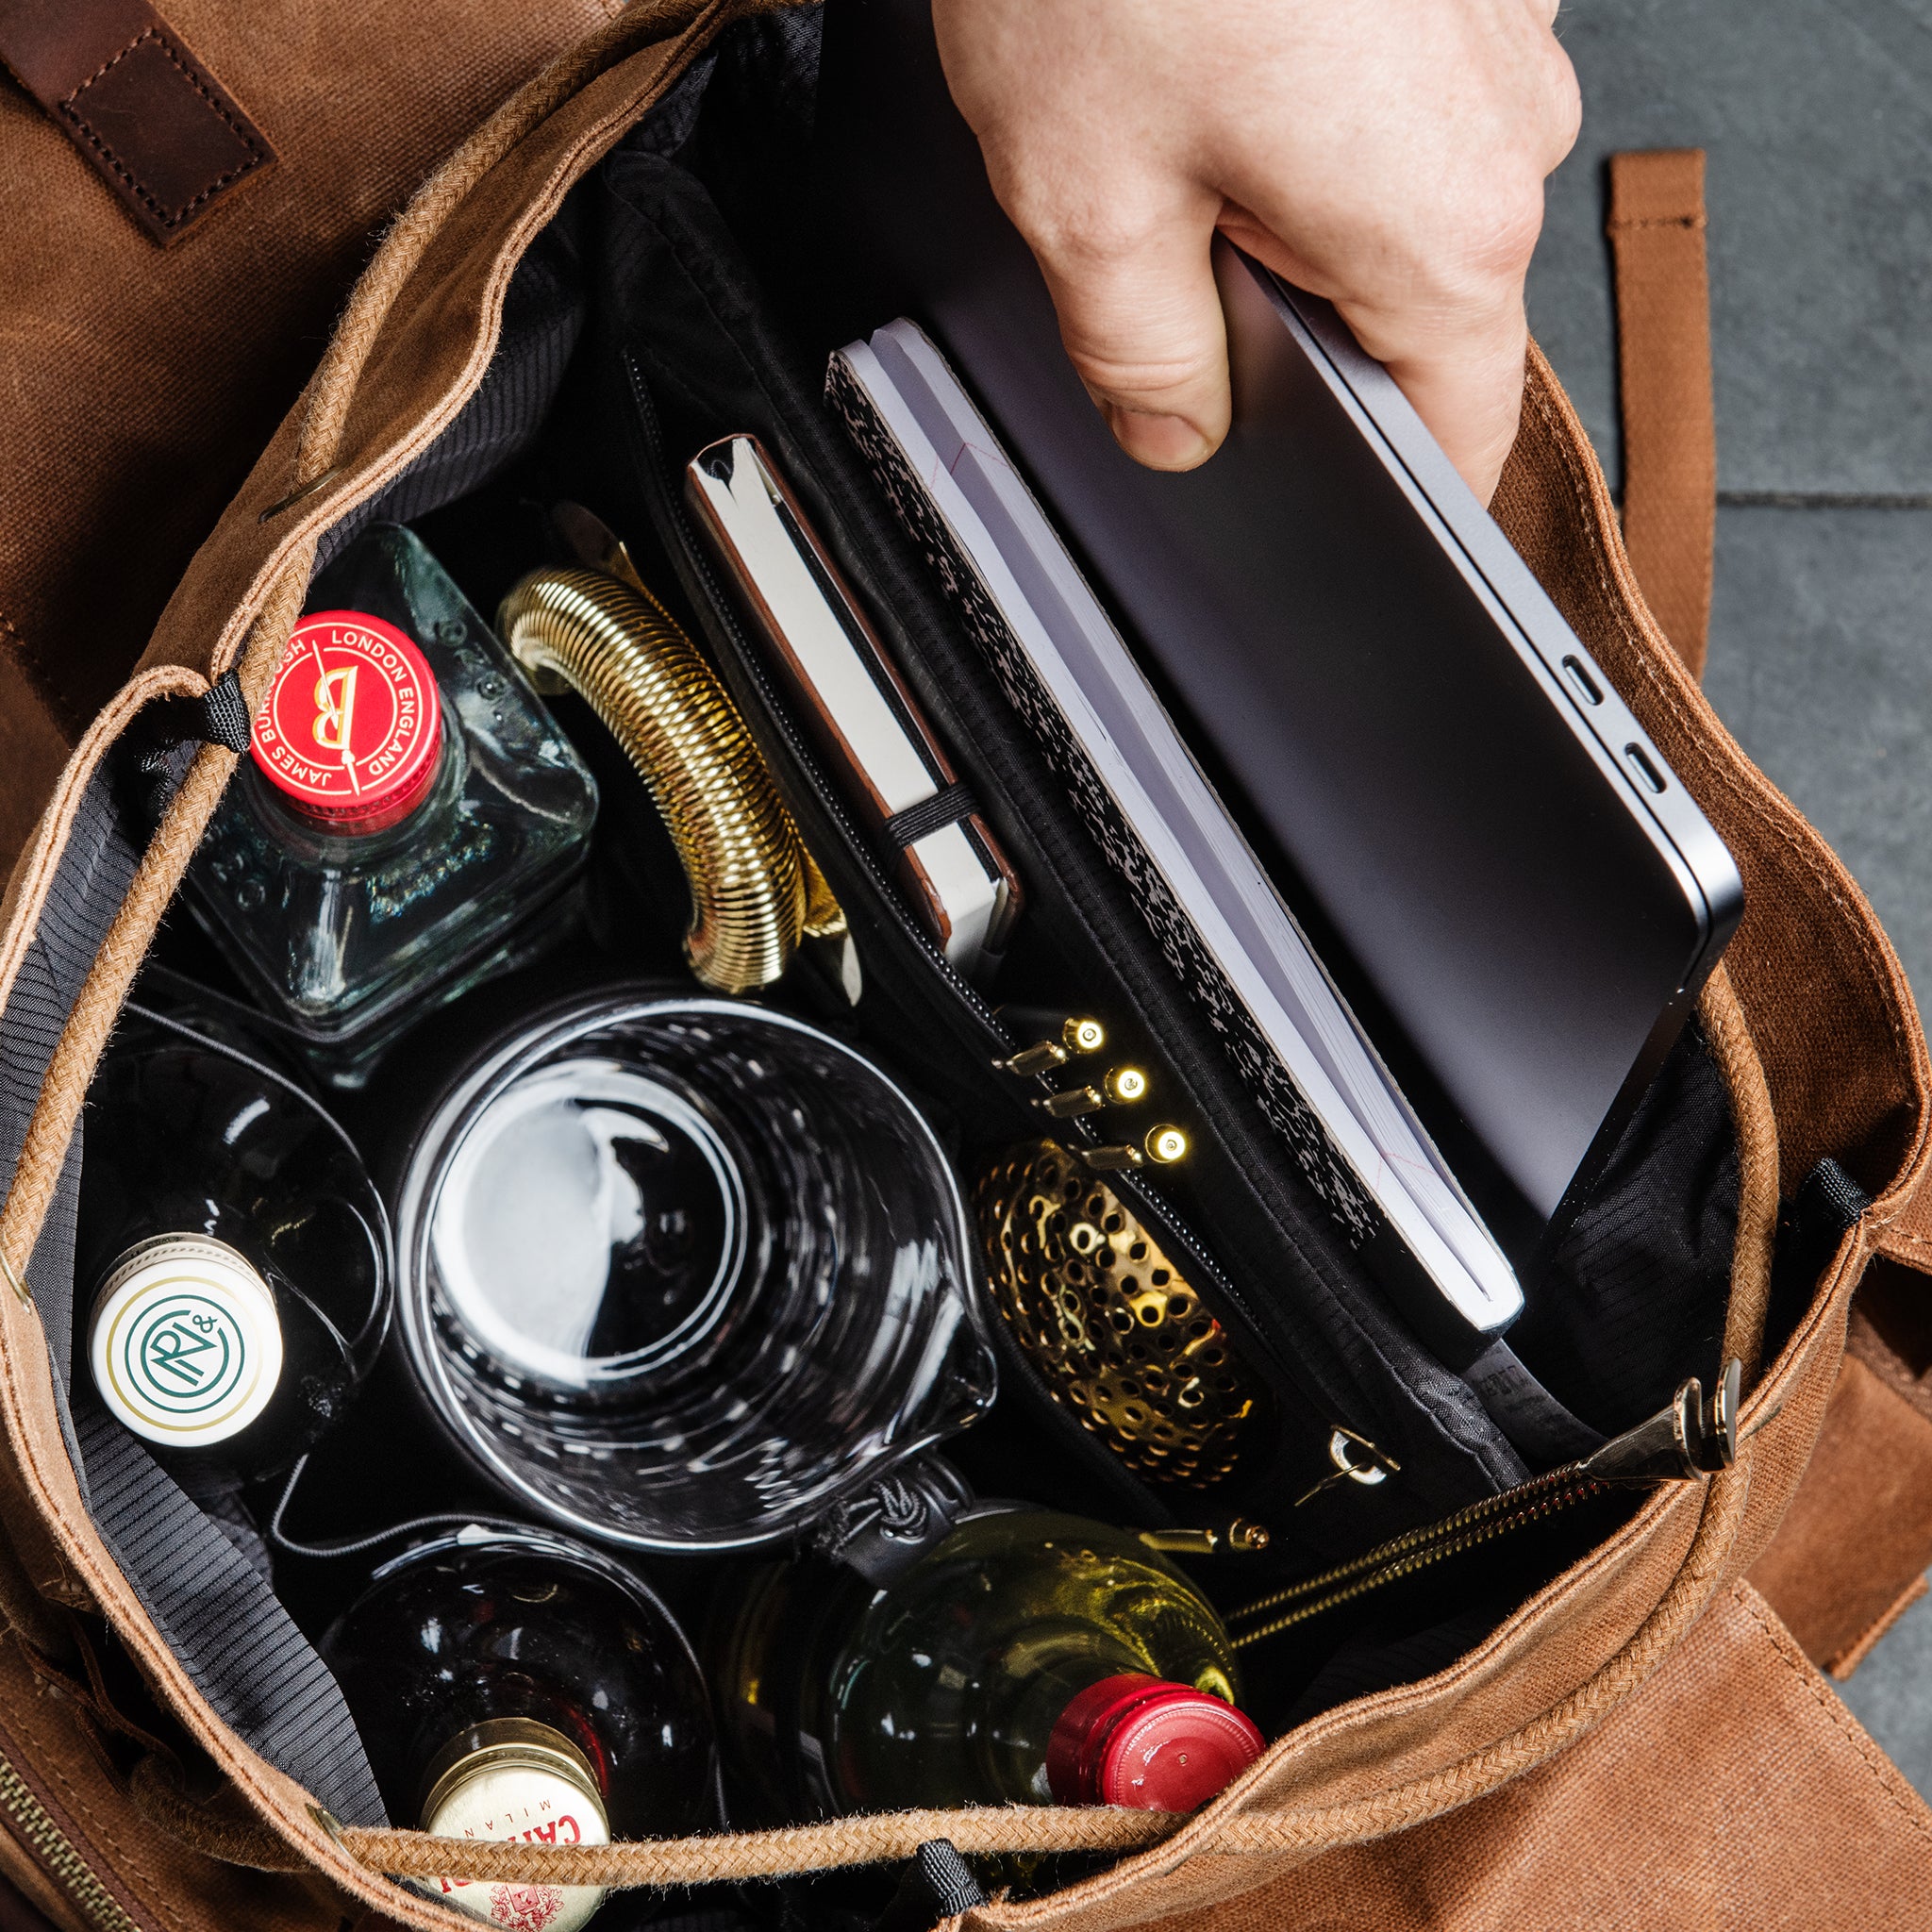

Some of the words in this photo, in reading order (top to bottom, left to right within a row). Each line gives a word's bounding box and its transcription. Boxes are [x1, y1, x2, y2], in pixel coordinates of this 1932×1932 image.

[331, 629, 408, 683] LONDON
[368, 686, 415, 775] ENGLAND
[272, 745, 332, 787] JAMES
